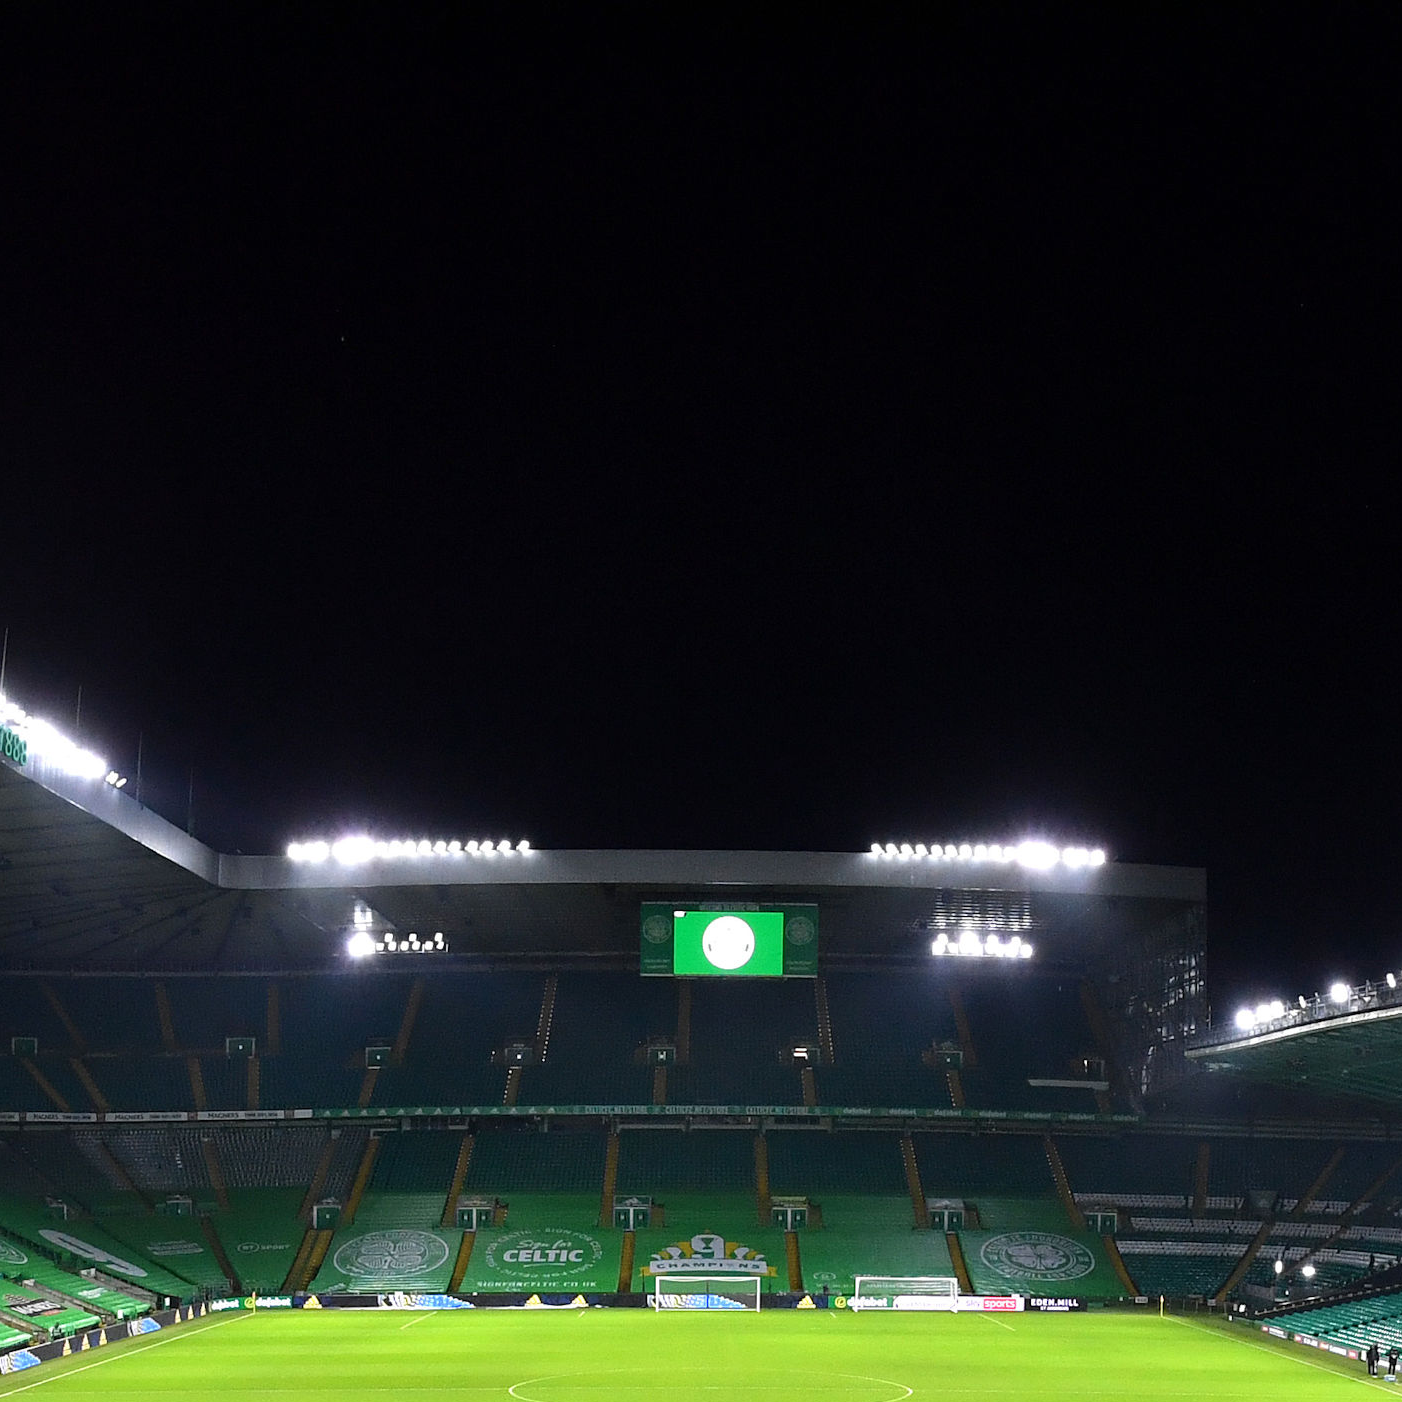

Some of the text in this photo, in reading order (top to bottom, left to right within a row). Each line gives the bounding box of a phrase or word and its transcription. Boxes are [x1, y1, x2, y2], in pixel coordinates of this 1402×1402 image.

[260, 1243, 291, 1251] SPORT
[516, 1240, 572, 1250] Sign for
[38, 1229, 148, 1277] 9
[503, 1250, 584, 1262] CELTIC
[255, 1297, 292, 1308] dafabet
[847, 1296, 888, 1308] dafabet
[985, 1299, 1016, 1310] sports
